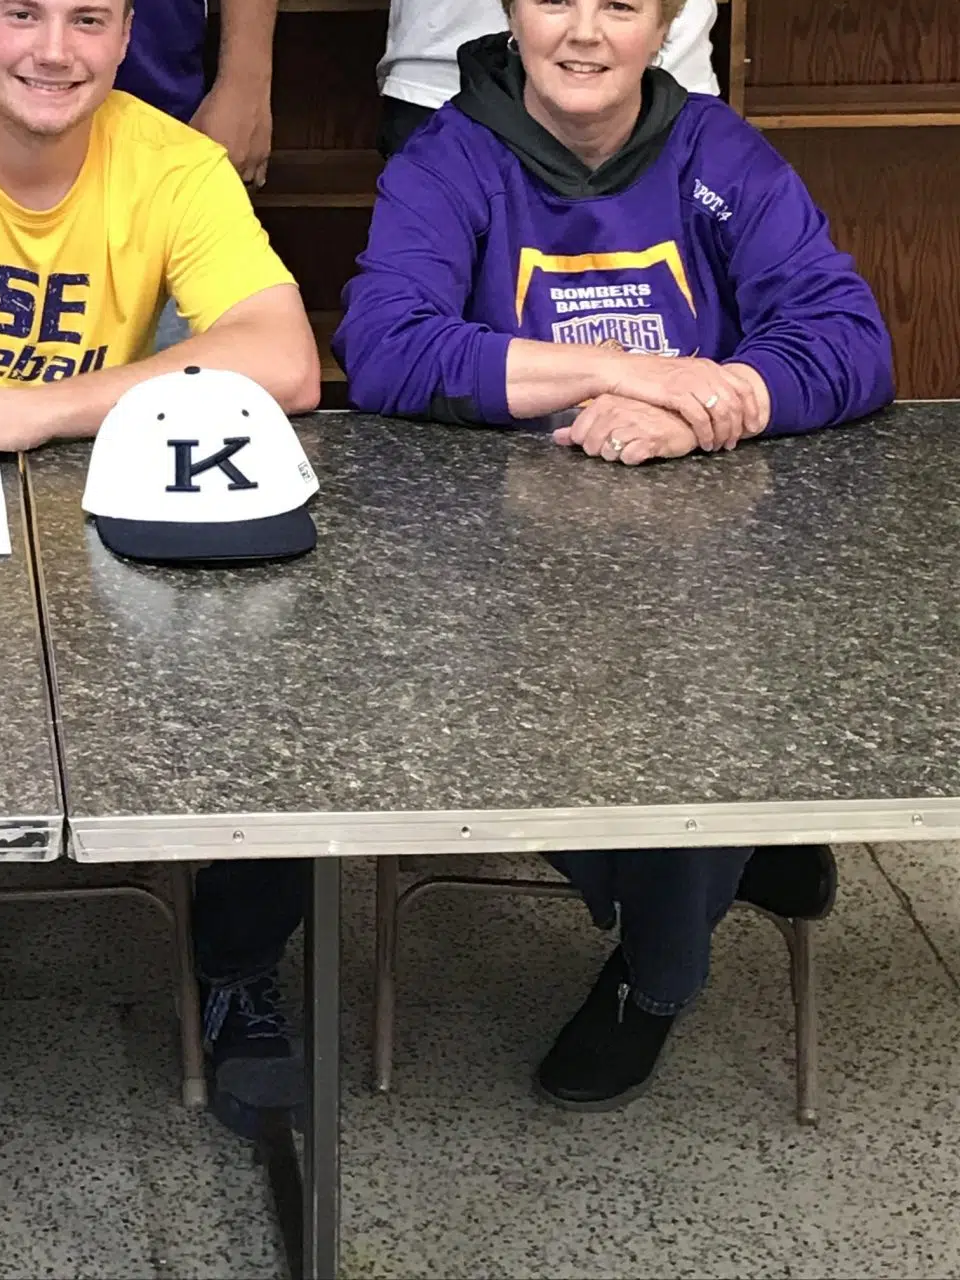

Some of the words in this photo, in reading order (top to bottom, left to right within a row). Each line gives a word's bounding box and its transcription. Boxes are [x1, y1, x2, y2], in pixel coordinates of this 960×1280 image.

[550, 283, 652, 300] BOMBERS
[555, 297, 652, 314] BASEBALL
[165, 435, 258, 493] K
